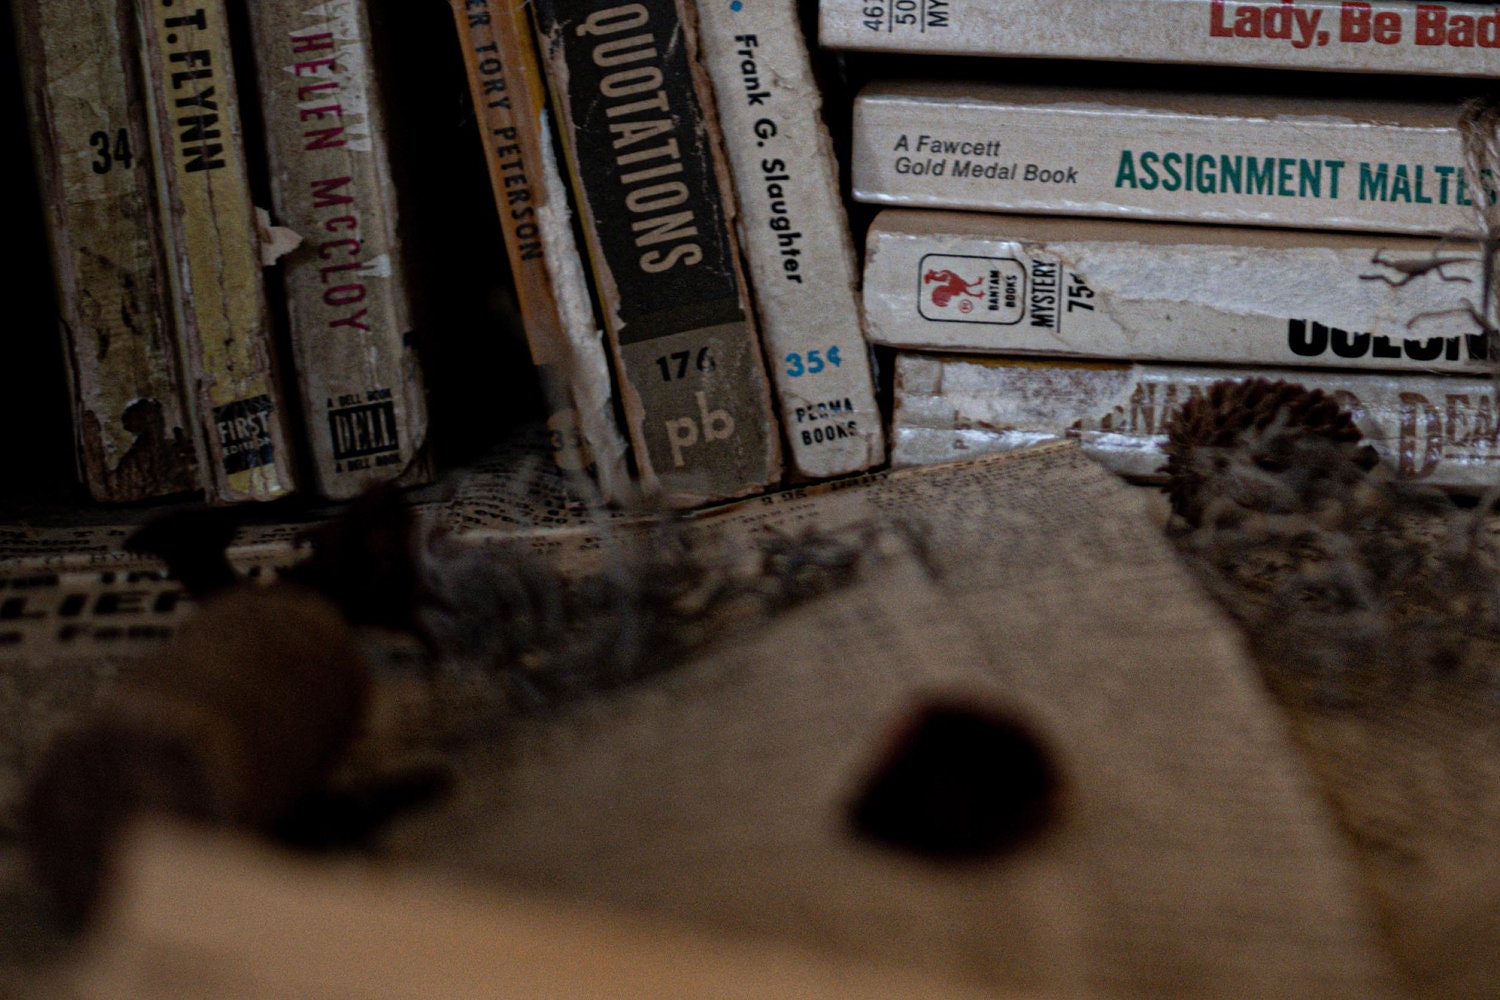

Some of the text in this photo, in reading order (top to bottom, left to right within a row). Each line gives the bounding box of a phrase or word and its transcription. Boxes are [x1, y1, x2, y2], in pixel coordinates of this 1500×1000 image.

[1340, 0, 1401, 46] Be
[291, 31, 346, 152] HELEN
[89, 128, 132, 174] 34
[475, 42, 510, 110] TORY
[494, 126, 542, 261] PETERSON
[575, 2, 703, 274] QUOTATIONS
[736, 33, 803, 285] Frank G. Slaughter
[893, 134, 1001, 157] A Fawcett
[894, 156, 1079, 185] Gold Medal Book
[1115, 149, 1345, 200] ASSIGNMENT
[988, 270, 999, 311] BANTAM
[1005, 275, 1017, 307] BOOKS
[1031, 260, 1056, 328] MYSTERY
[786, 346, 841, 377] 35¢
[218, 410, 271, 445] FIRST
[334, 405, 396, 454] DELL
[665, 391, 735, 467] pb
[802, 421, 857, 446] BOOKS
